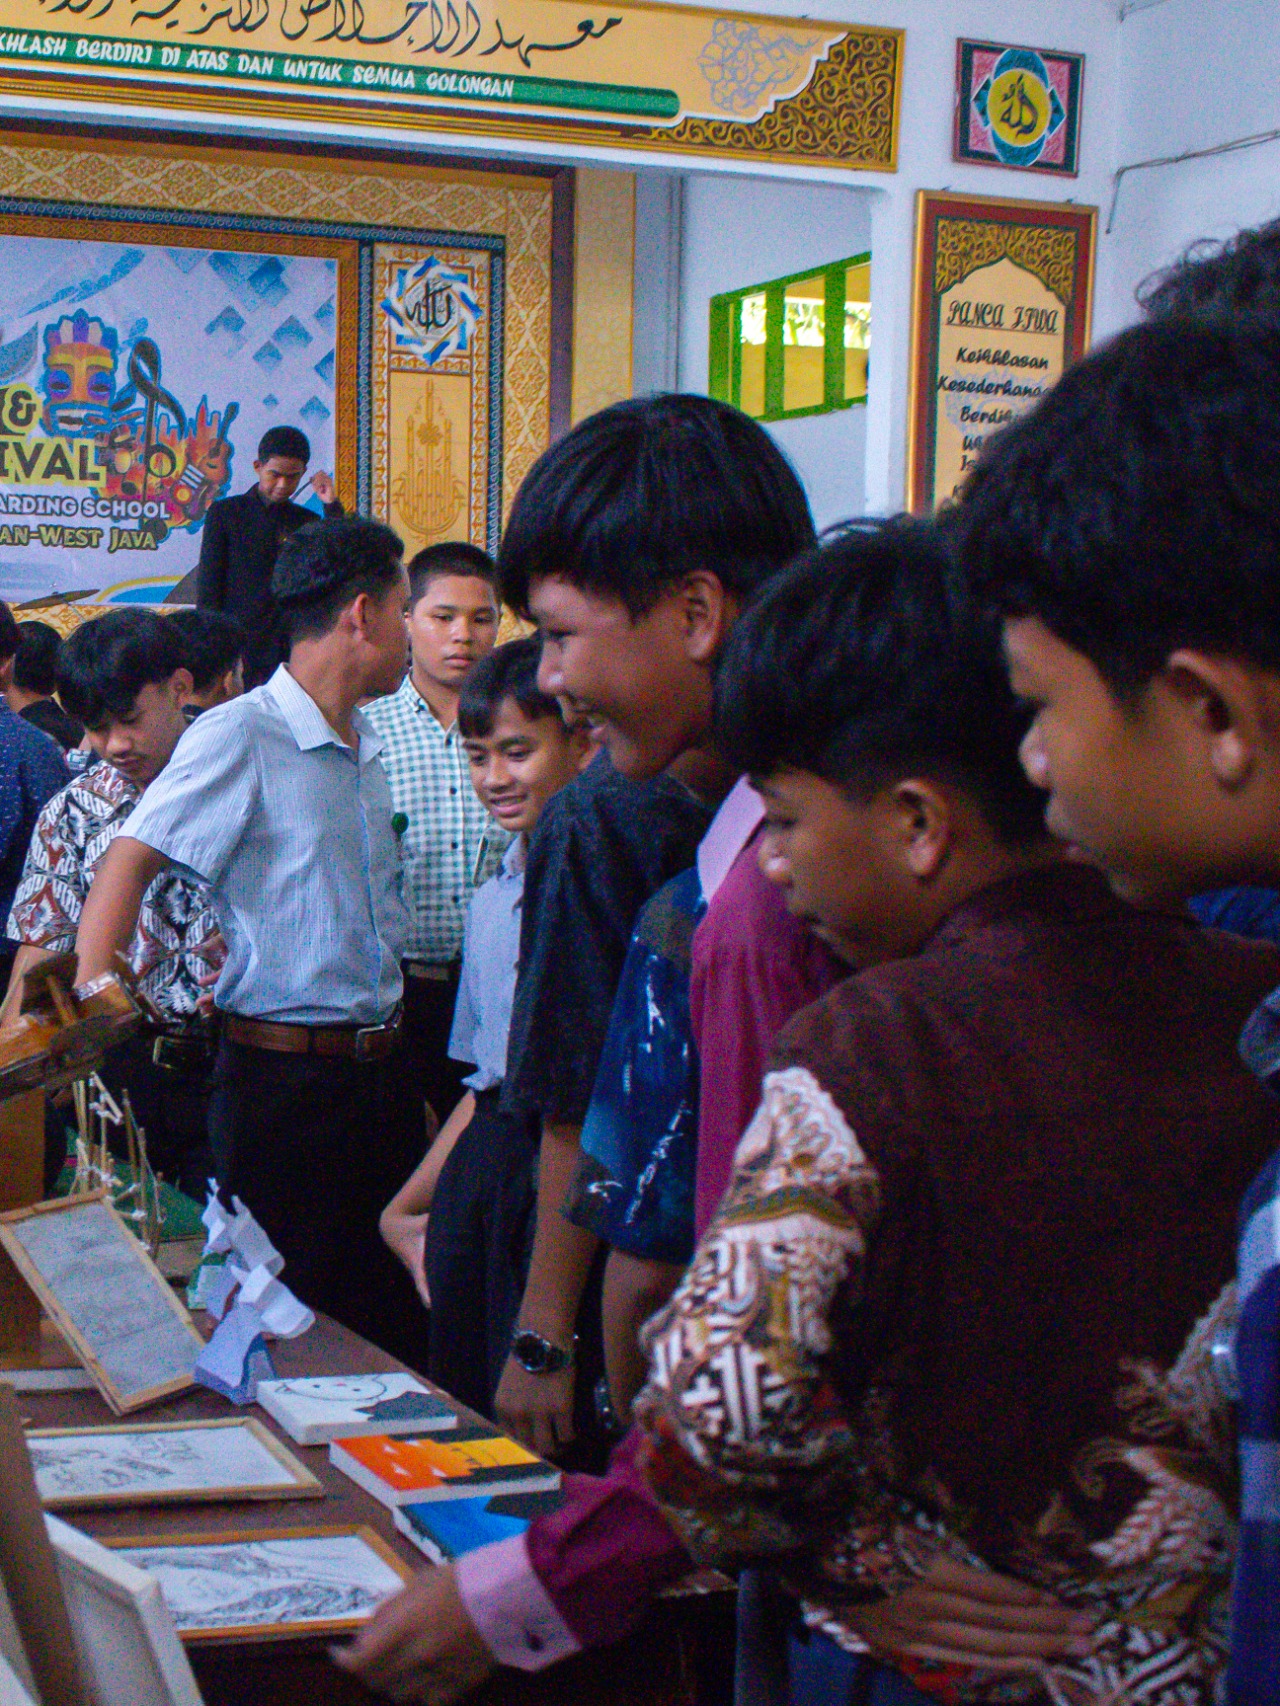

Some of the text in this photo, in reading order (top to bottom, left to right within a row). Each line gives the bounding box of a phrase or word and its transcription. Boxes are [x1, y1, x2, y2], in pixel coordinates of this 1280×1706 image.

[75, 39, 152, 64] BERDIRI
[161, 47, 180, 67] DI
[186, 50, 230, 71] ATAS
[237, 54, 275, 76] DAN
[282, 59, 343, 83] UNTUK
[352, 64, 416, 89] SEMUA
[425, 73, 515, 98] GOLONGAN
[946, 300, 1004, 328] PANCA
[956, 347, 1049, 369] Keikhlasan
[937, 375, 1049, 397] Kesederhana
[6, 390, 38, 428] &
[81, 498, 171, 519] SCHOOL
[107, 528, 158, 553] JAVA
